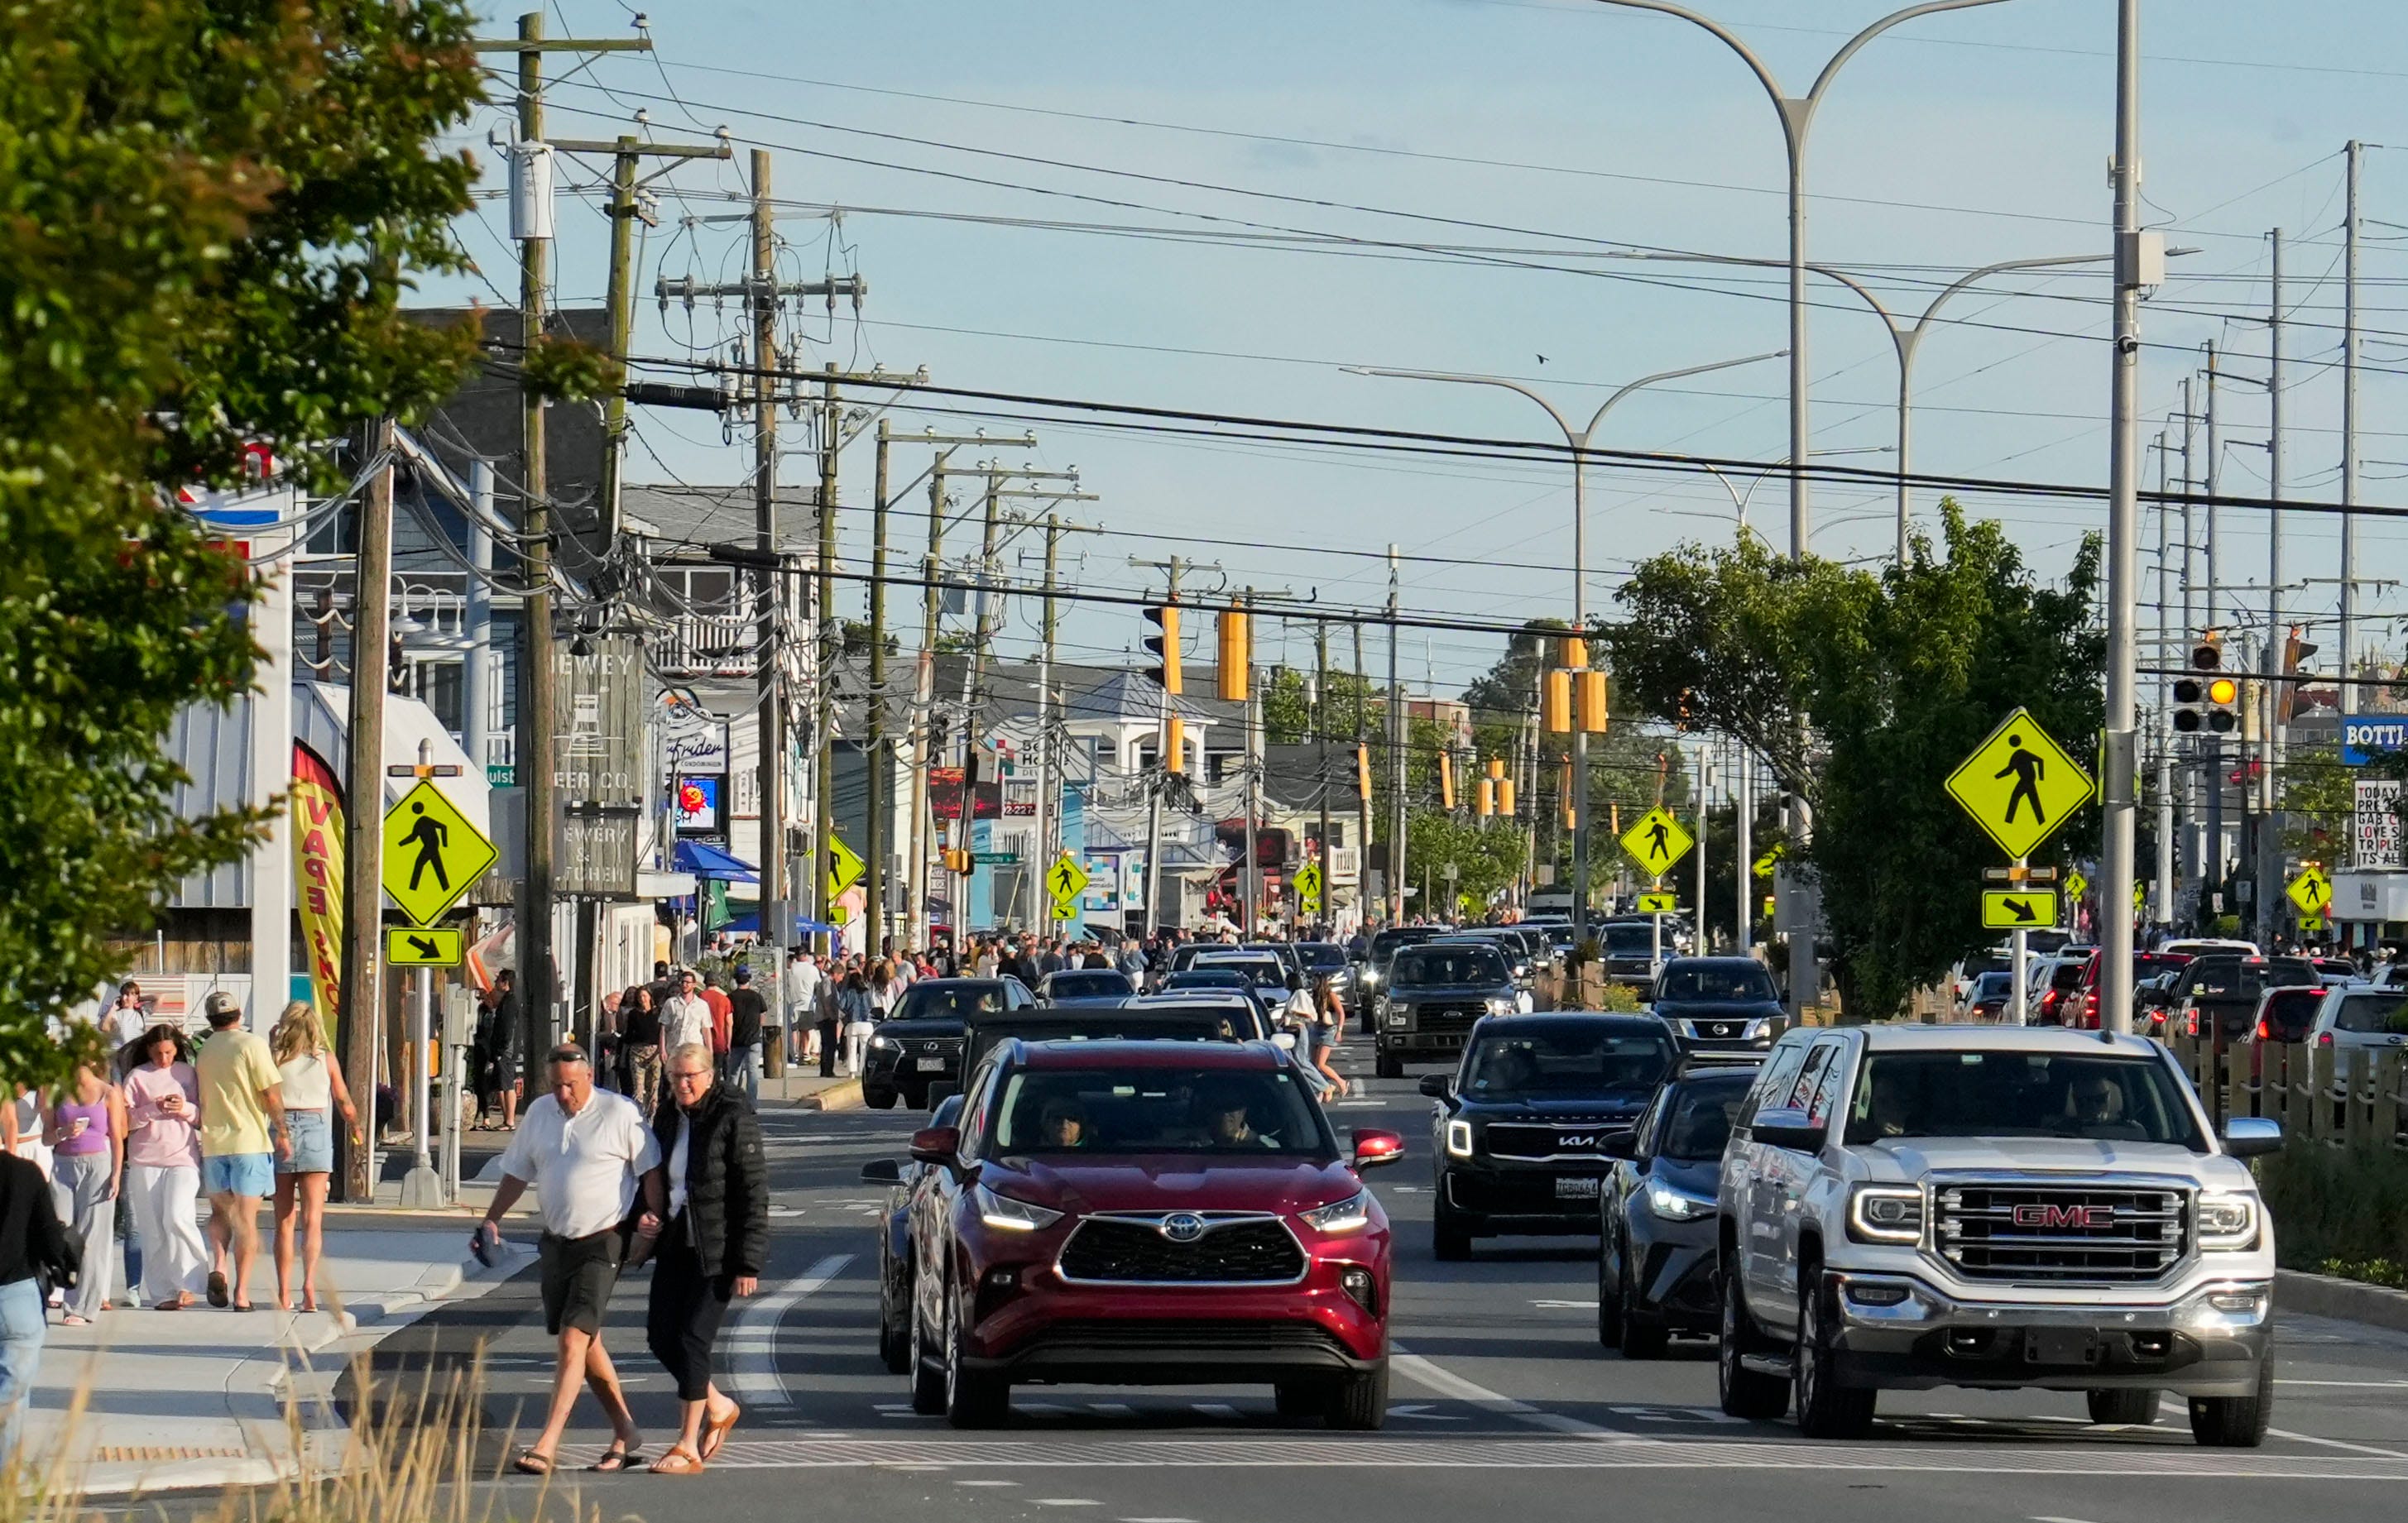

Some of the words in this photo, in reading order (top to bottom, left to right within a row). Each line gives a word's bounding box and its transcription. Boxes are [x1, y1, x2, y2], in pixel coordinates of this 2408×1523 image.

[551, 654, 633, 675] EWEY
[554, 772, 589, 788] EER
[2358, 788, 2398, 799] TODAY
[2358, 813, 2382, 825] GAB
[564, 826, 628, 842] EWERY
[2013, 1205, 2113, 1228] GMC
